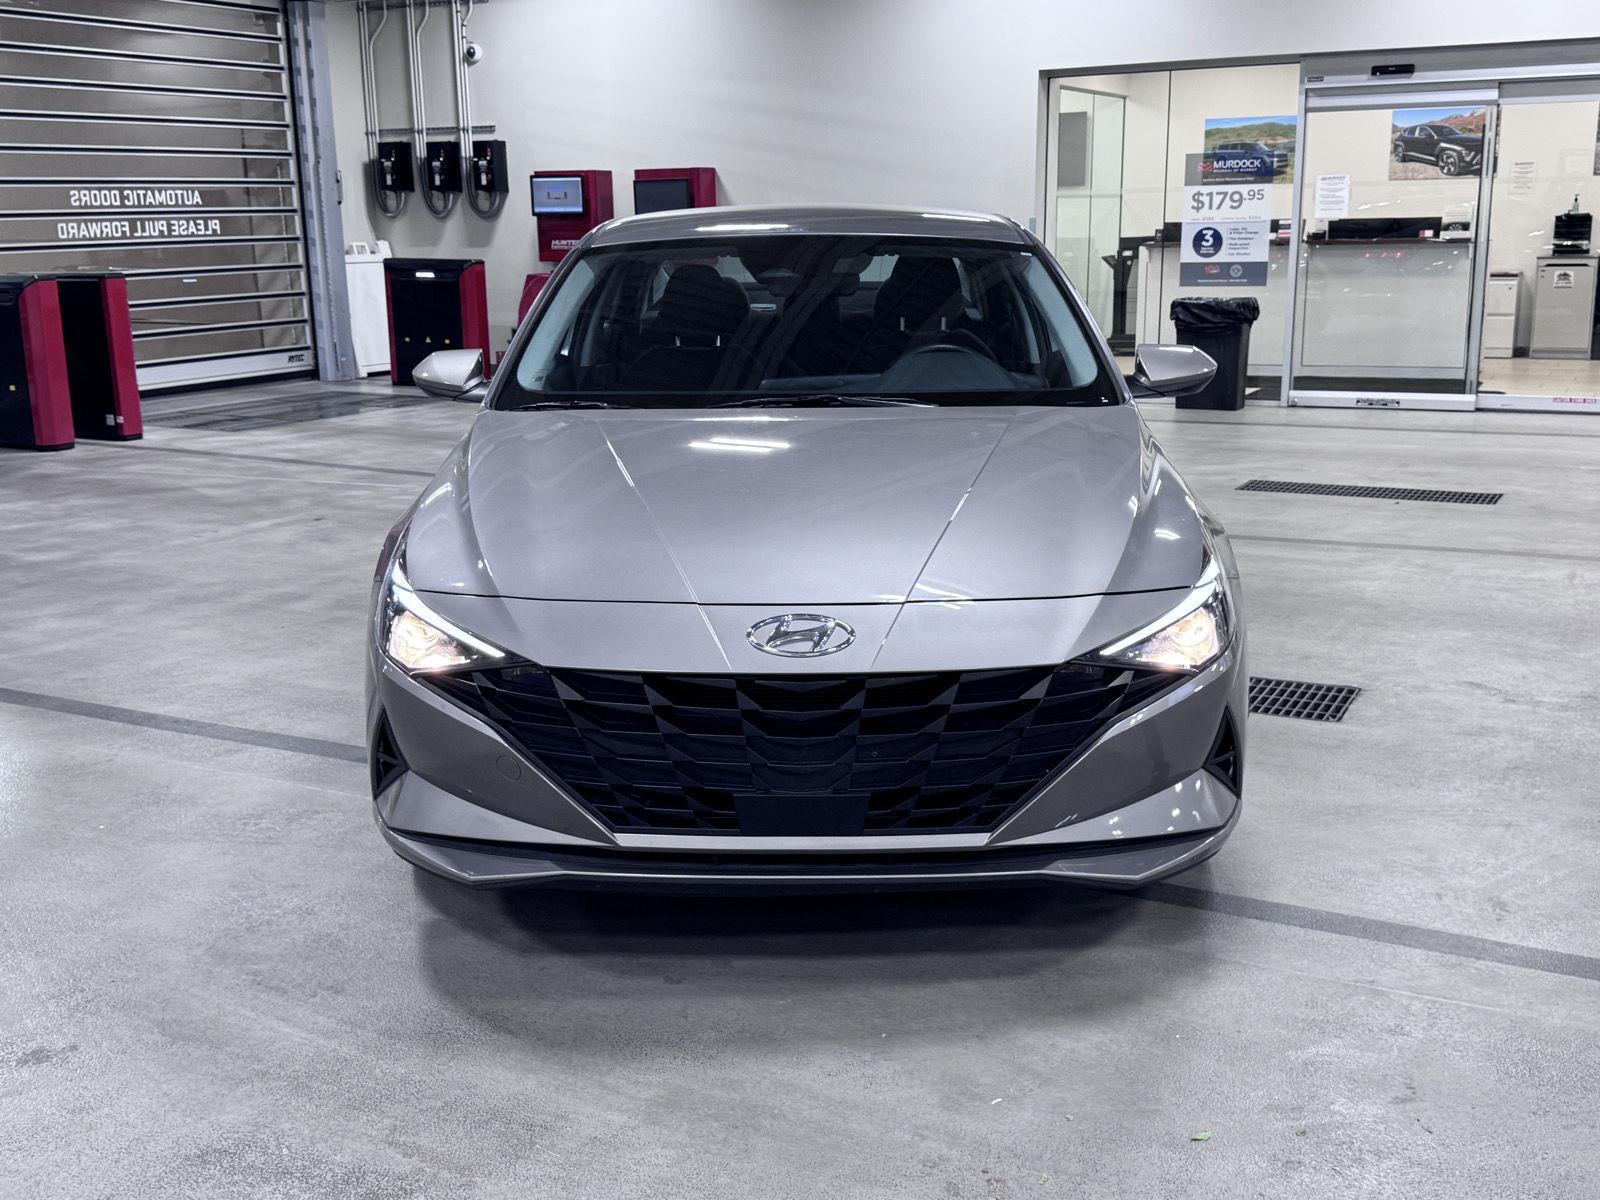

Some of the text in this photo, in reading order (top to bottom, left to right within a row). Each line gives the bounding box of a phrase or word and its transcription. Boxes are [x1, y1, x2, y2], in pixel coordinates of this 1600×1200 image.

[1213, 159, 1261, 169] MURDOCK
[1191, 189, 1264, 213] $179.95
[1201, 229, 1214, 247] 3
